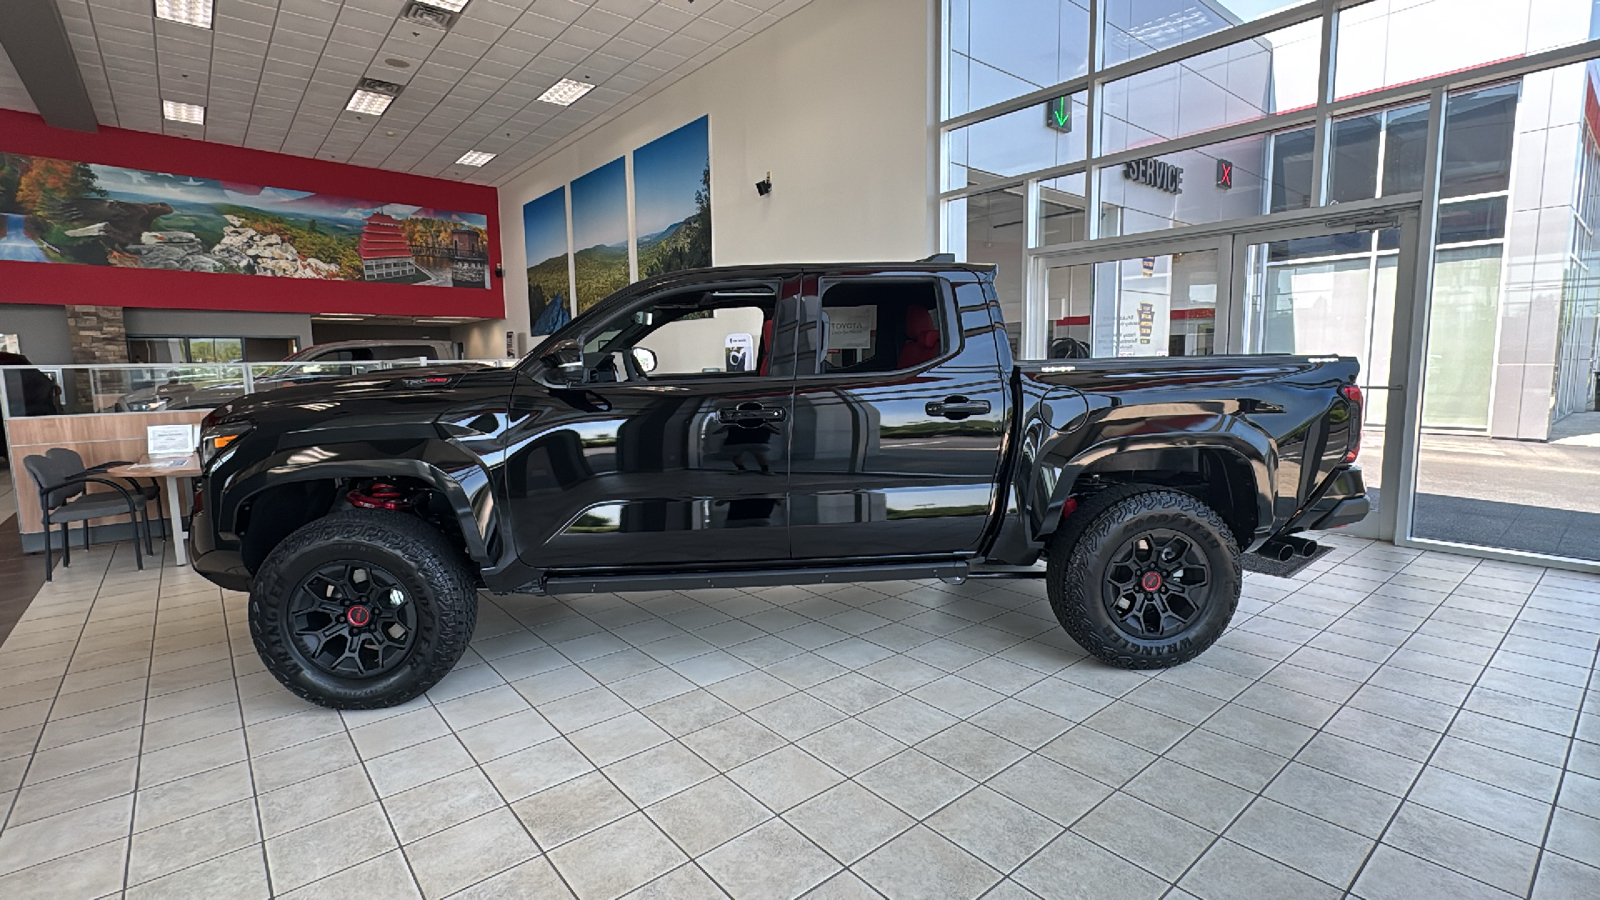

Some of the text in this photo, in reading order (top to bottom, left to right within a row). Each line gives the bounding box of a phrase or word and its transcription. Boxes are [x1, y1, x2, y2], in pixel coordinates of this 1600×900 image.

[1125, 159, 1183, 194] SERVICE
[831, 322, 863, 331] TOYOTA
[265, 576, 303, 674] WRANGLER
[1102, 624, 1194, 655] WRANGLER
